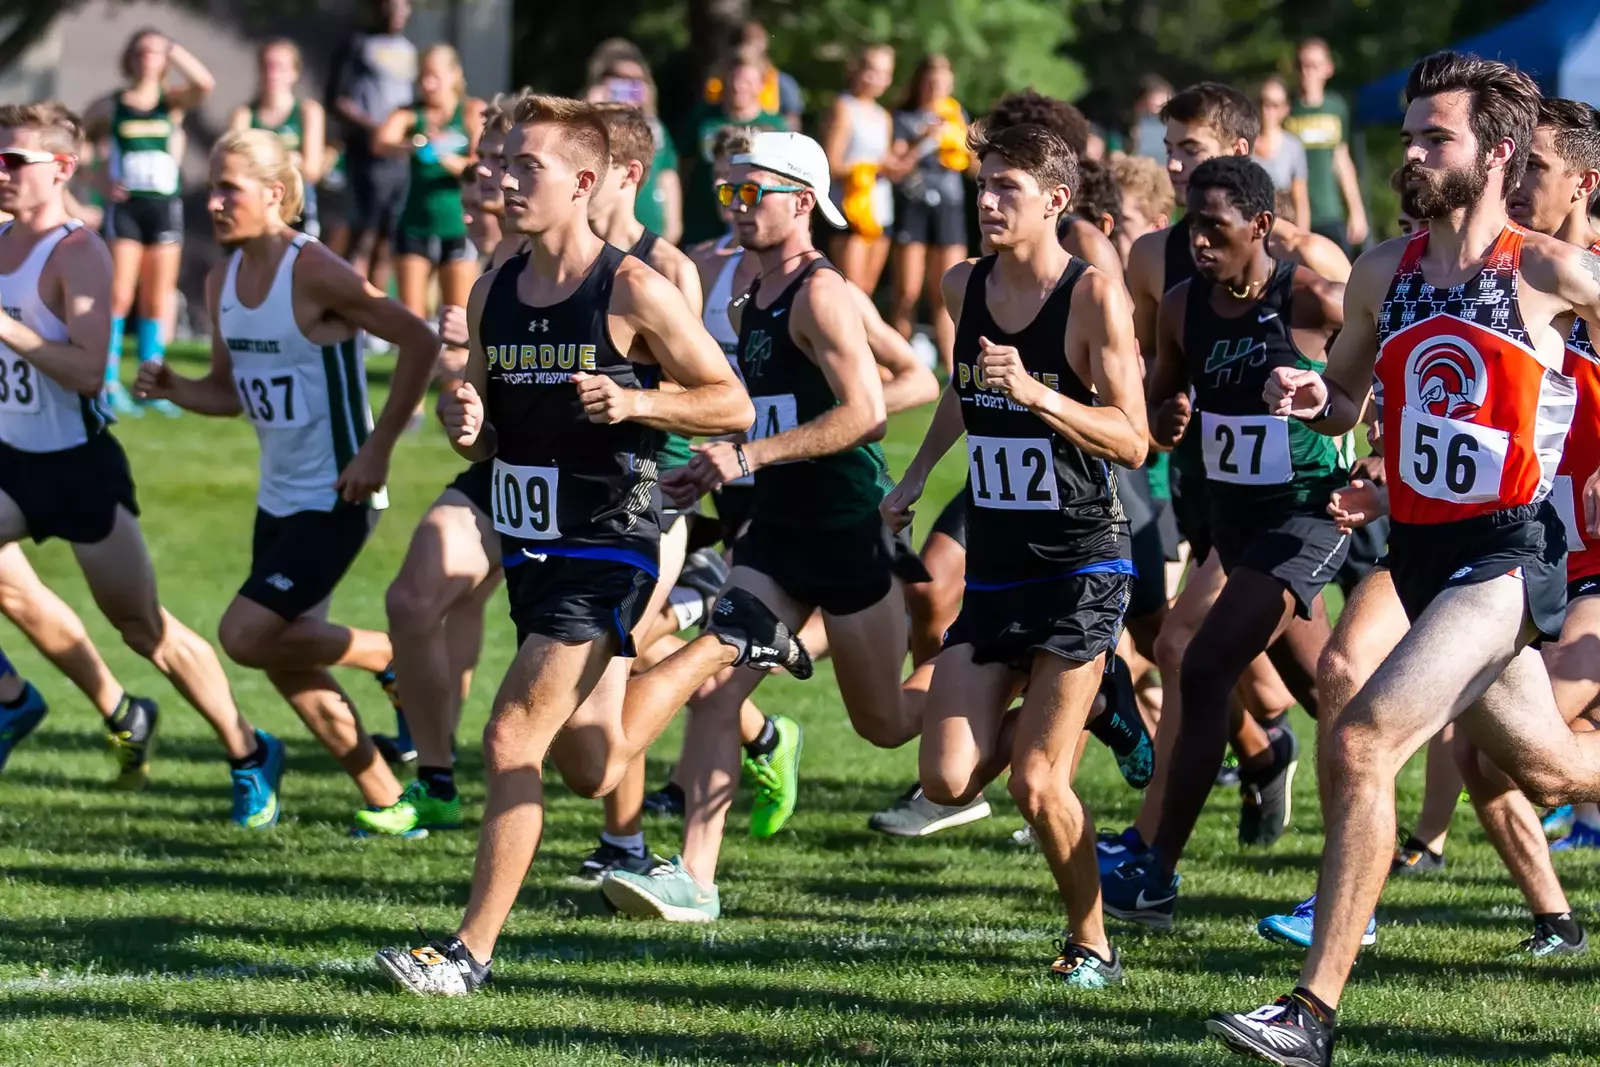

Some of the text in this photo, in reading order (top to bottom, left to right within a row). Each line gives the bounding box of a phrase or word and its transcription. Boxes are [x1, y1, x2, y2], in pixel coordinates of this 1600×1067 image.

[1480, 281, 1497, 289] TECH
[1491, 310, 1510, 318] TECH
[486, 343, 597, 370] PURDUE
[501, 372, 533, 385] FORT
[240, 375, 295, 422] 137
[974, 393, 1005, 410] FORT
[1215, 424, 1267, 475] 27
[1413, 422, 1480, 494] 56
[972, 445, 1052, 502] 112
[494, 468, 550, 533] 109
